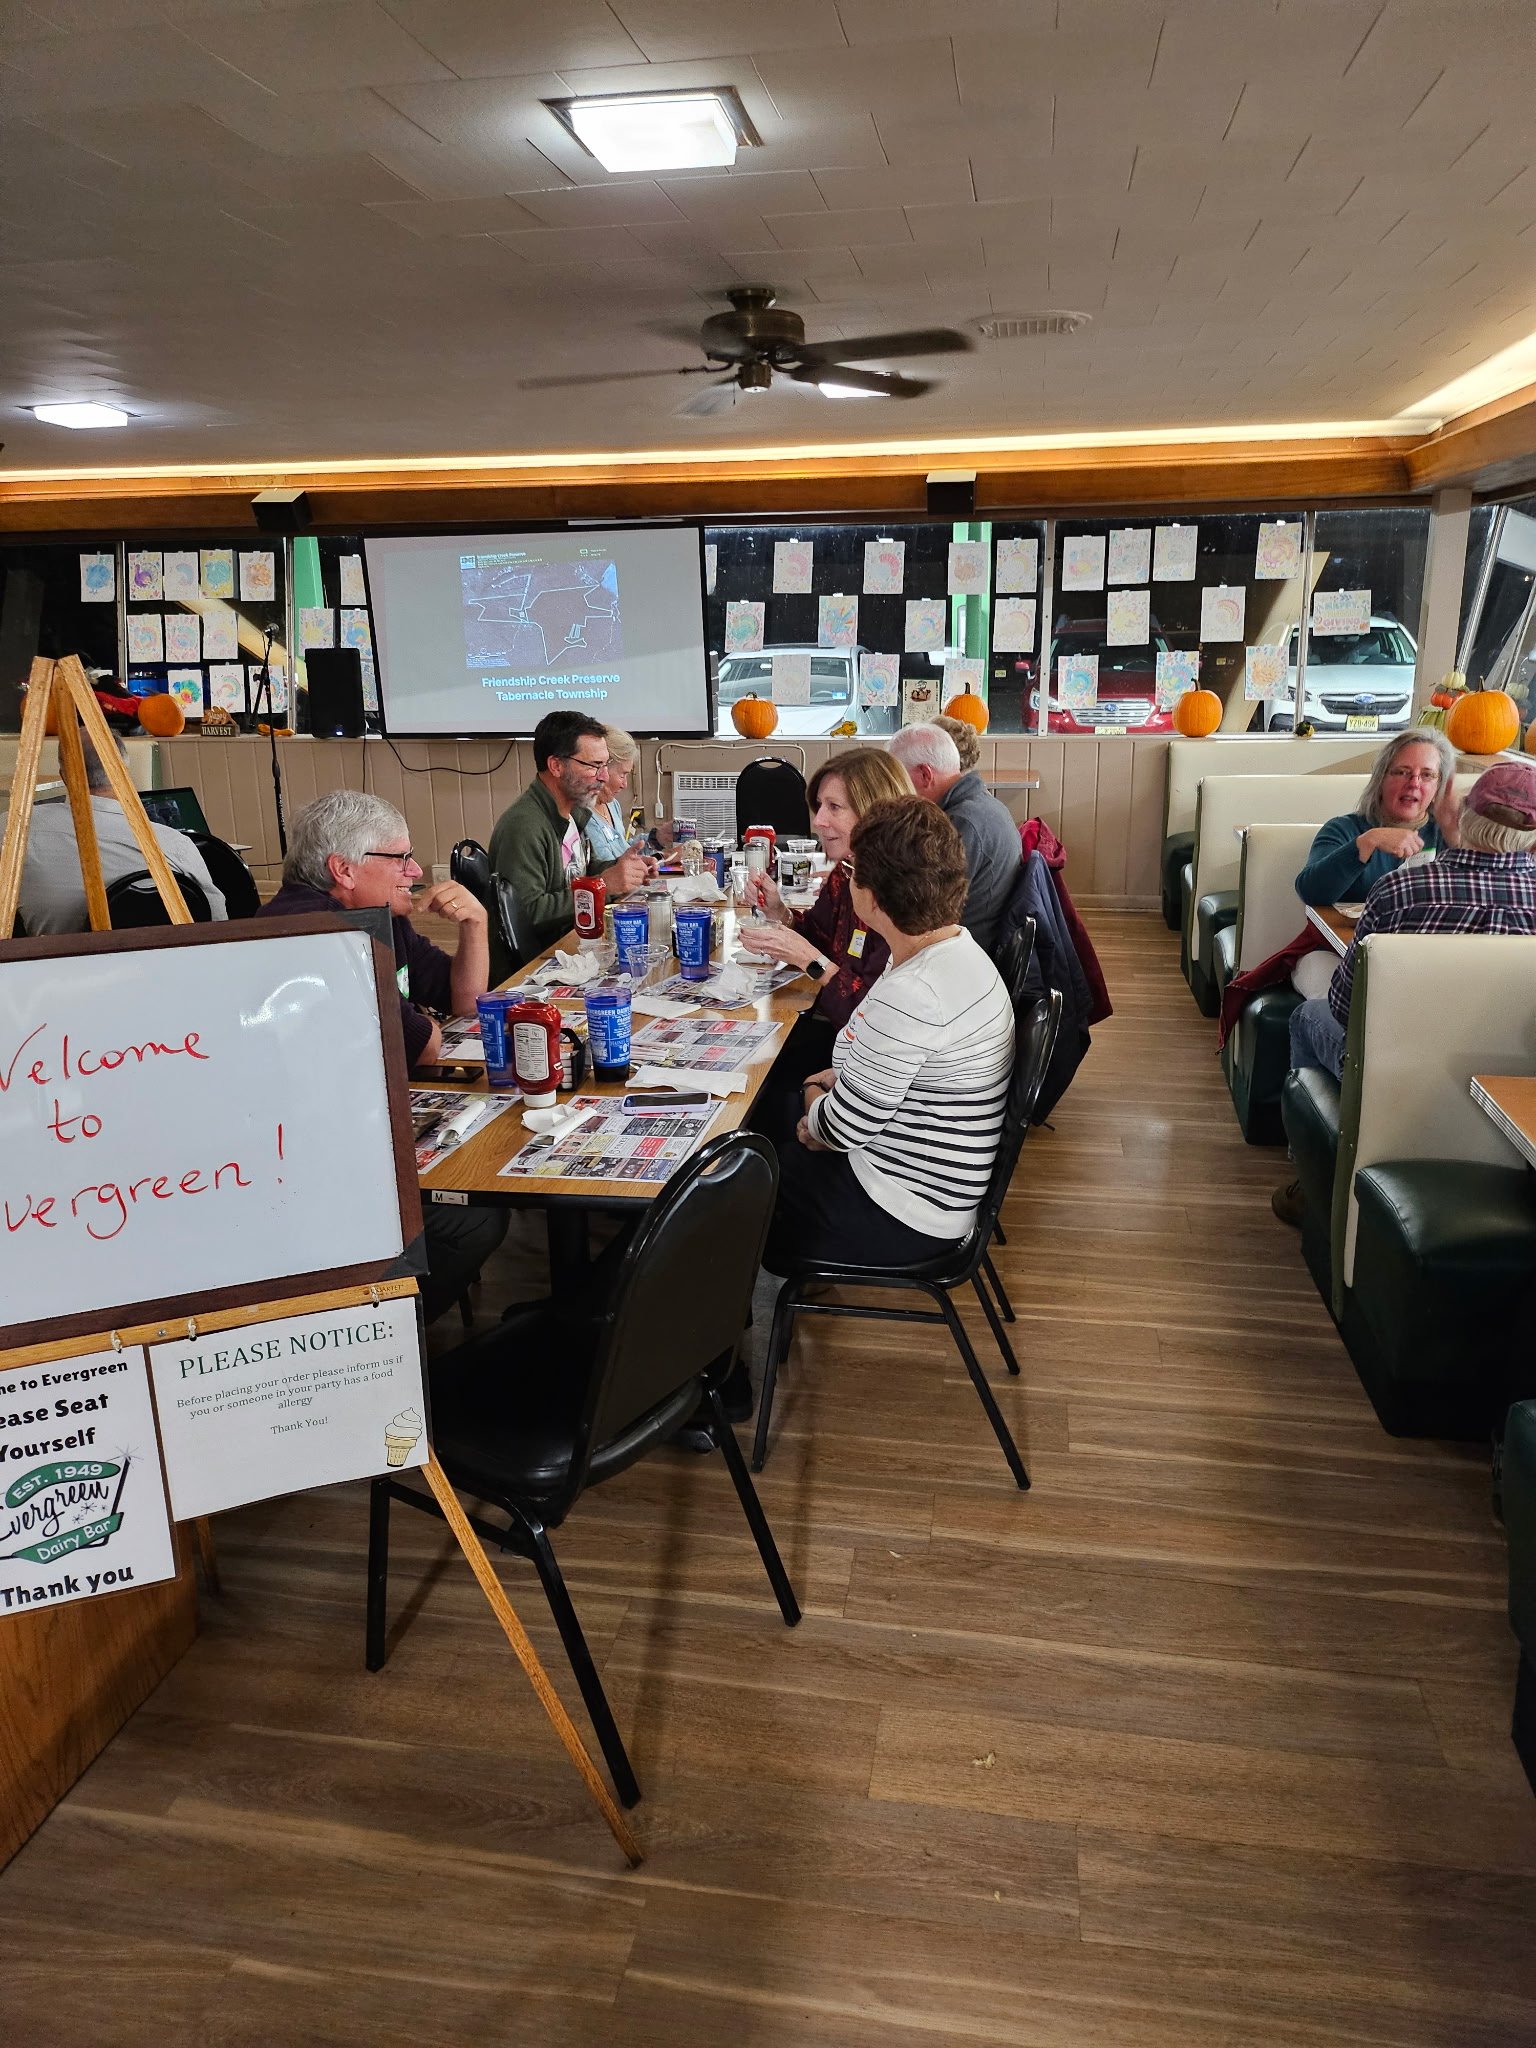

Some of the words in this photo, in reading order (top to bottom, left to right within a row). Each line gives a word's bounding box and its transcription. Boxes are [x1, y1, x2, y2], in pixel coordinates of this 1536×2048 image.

[481, 675, 537, 688] Friendship
[538, 674, 570, 686] Creek
[572, 673, 621, 684] Preserve
[496, 689, 554, 701] Tabernacle
[556, 688, 608, 701] Township
[201, 726, 232, 736] HARVEST
[47, 1098, 102, 1143] to
[5, 1162, 252, 1240] vergreen
[435, 1192, 443, 1202] M
[178, 1339, 282, 1379] PLEASE
[289, 1321, 394, 1355] NOTICE:
[20, 1379, 38, 1391] to
[42, 1362, 128, 1387] Evergreen
[177, 1395, 213, 1408] Before
[215, 1385, 253, 1402] placing
[255, 1379, 280, 1392] your
[281, 1373, 310, 1385] order
[312, 1368, 345, 1381] please
[347, 1360, 380, 1373] inform
[382, 1358, 394, 1366] us
[396, 1354, 404, 1364] if
[190, 1408, 210, 1420] you
[213, 1403, 225, 1413] or
[227, 1393, 274, 1410] someone
[276, 1389, 286, 1398] in
[288, 1384, 313, 1397] your
[314, 1379, 342, 1393] party
[344, 1376, 361, 1386] has
[371, 1368, 394, 1380] food
[0, 1407, 49, 1430] ease
[54, 1393, 109, 1418] Seat
[277, 1396, 313, 1410] allergy
[270, 1420, 303, 1435] Thank
[305, 1416, 329, 1428] You!
[0, 1427, 96, 1462] Yourself
[12, 1475, 49, 1500] EST.
[55, 1464, 103, 1480] 1949
[37, 1535, 80, 1561] Dairy
[83, 1520, 111, 1539] Bar
[0, 1575, 81, 1607] Thank
[86, 1567, 134, 1593] you
